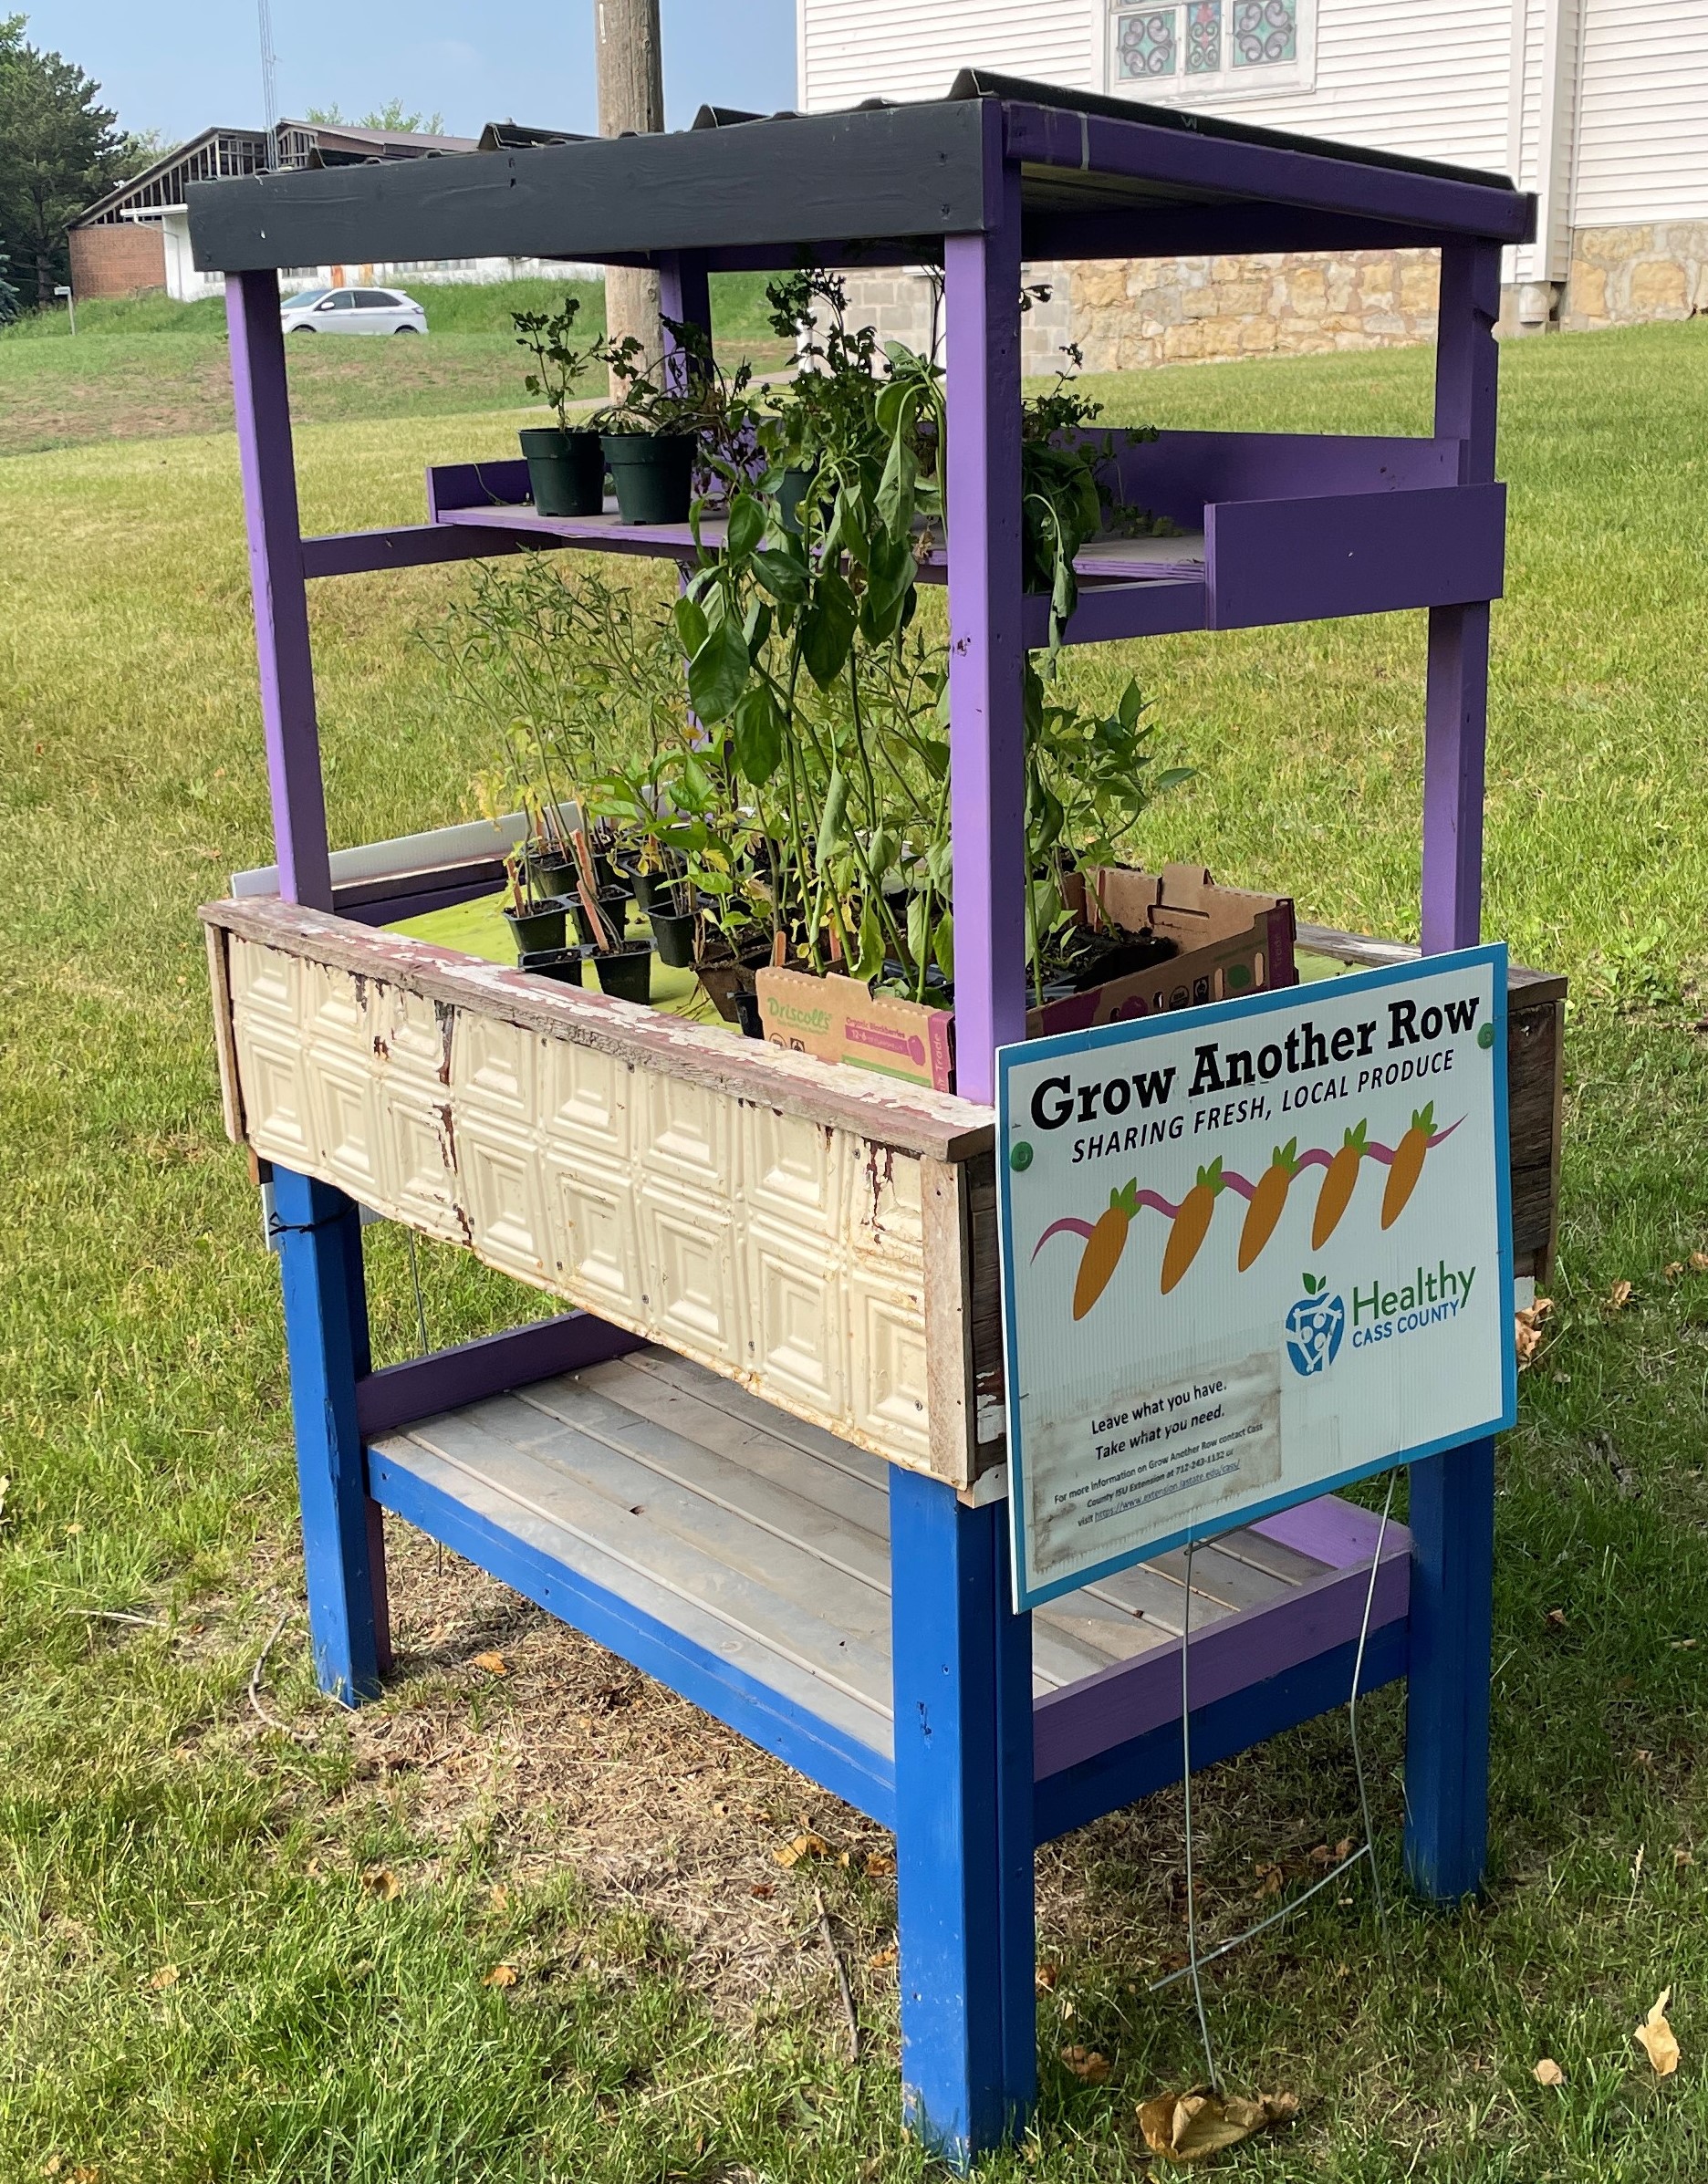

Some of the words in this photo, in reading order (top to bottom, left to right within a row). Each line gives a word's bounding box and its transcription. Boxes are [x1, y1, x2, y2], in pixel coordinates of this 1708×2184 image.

[767, 997, 833, 1030] Driscoll's
[933, 1033, 943, 1072] Trade
[1031, 1066, 1176, 1129] Grow
[1188, 1021, 1376, 1097] Another
[1388, 997, 1479, 1049] Row
[1072, 1116, 1183, 1163] SHARING
[1194, 1097, 1272, 1133] FRESH,
[1283, 1076, 1349, 1111] LOCAL
[1358, 1049, 1454, 1092] PRODUCE
[1353, 1260, 1476, 1326] Healthy
[1352, 1321, 1392, 1347] CASS
[1397, 1298, 1459, 1333] COUNTY
[1091, 1412, 1130, 1435] Leave
[1132, 1402, 1164, 1420] what
[1167, 1391, 1190, 1412] you
[1193, 1380, 1227, 1399] have.
[1095, 1440, 1126, 1460] Take
[1130, 1427, 1161, 1449] what
[1164, 1420, 1187, 1440] you
[1191, 1404, 1224, 1428] need.
[1054, 1493, 1068, 1504] For
[1069, 1485, 1089, 1499] more
[1138, 1464, 1147, 1473] on
[1149, 1456, 1169, 1469] Grow
[1171, 1445, 1200, 1461] Another
[1201, 1439, 1217, 1450] Row
[1219, 1429, 1246, 1443] contact
[1247, 1423, 1263, 1434] Cass
[1087, 1492, 1114, 1508] County
[1116, 1486, 1128, 1497] ISU
[1130, 1473, 1165, 1492] Extension
[1166, 1470, 1174, 1478] at
[1176, 1451, 1224, 1475] 712-243-1132
[1078, 1514, 1094, 1526] visit
